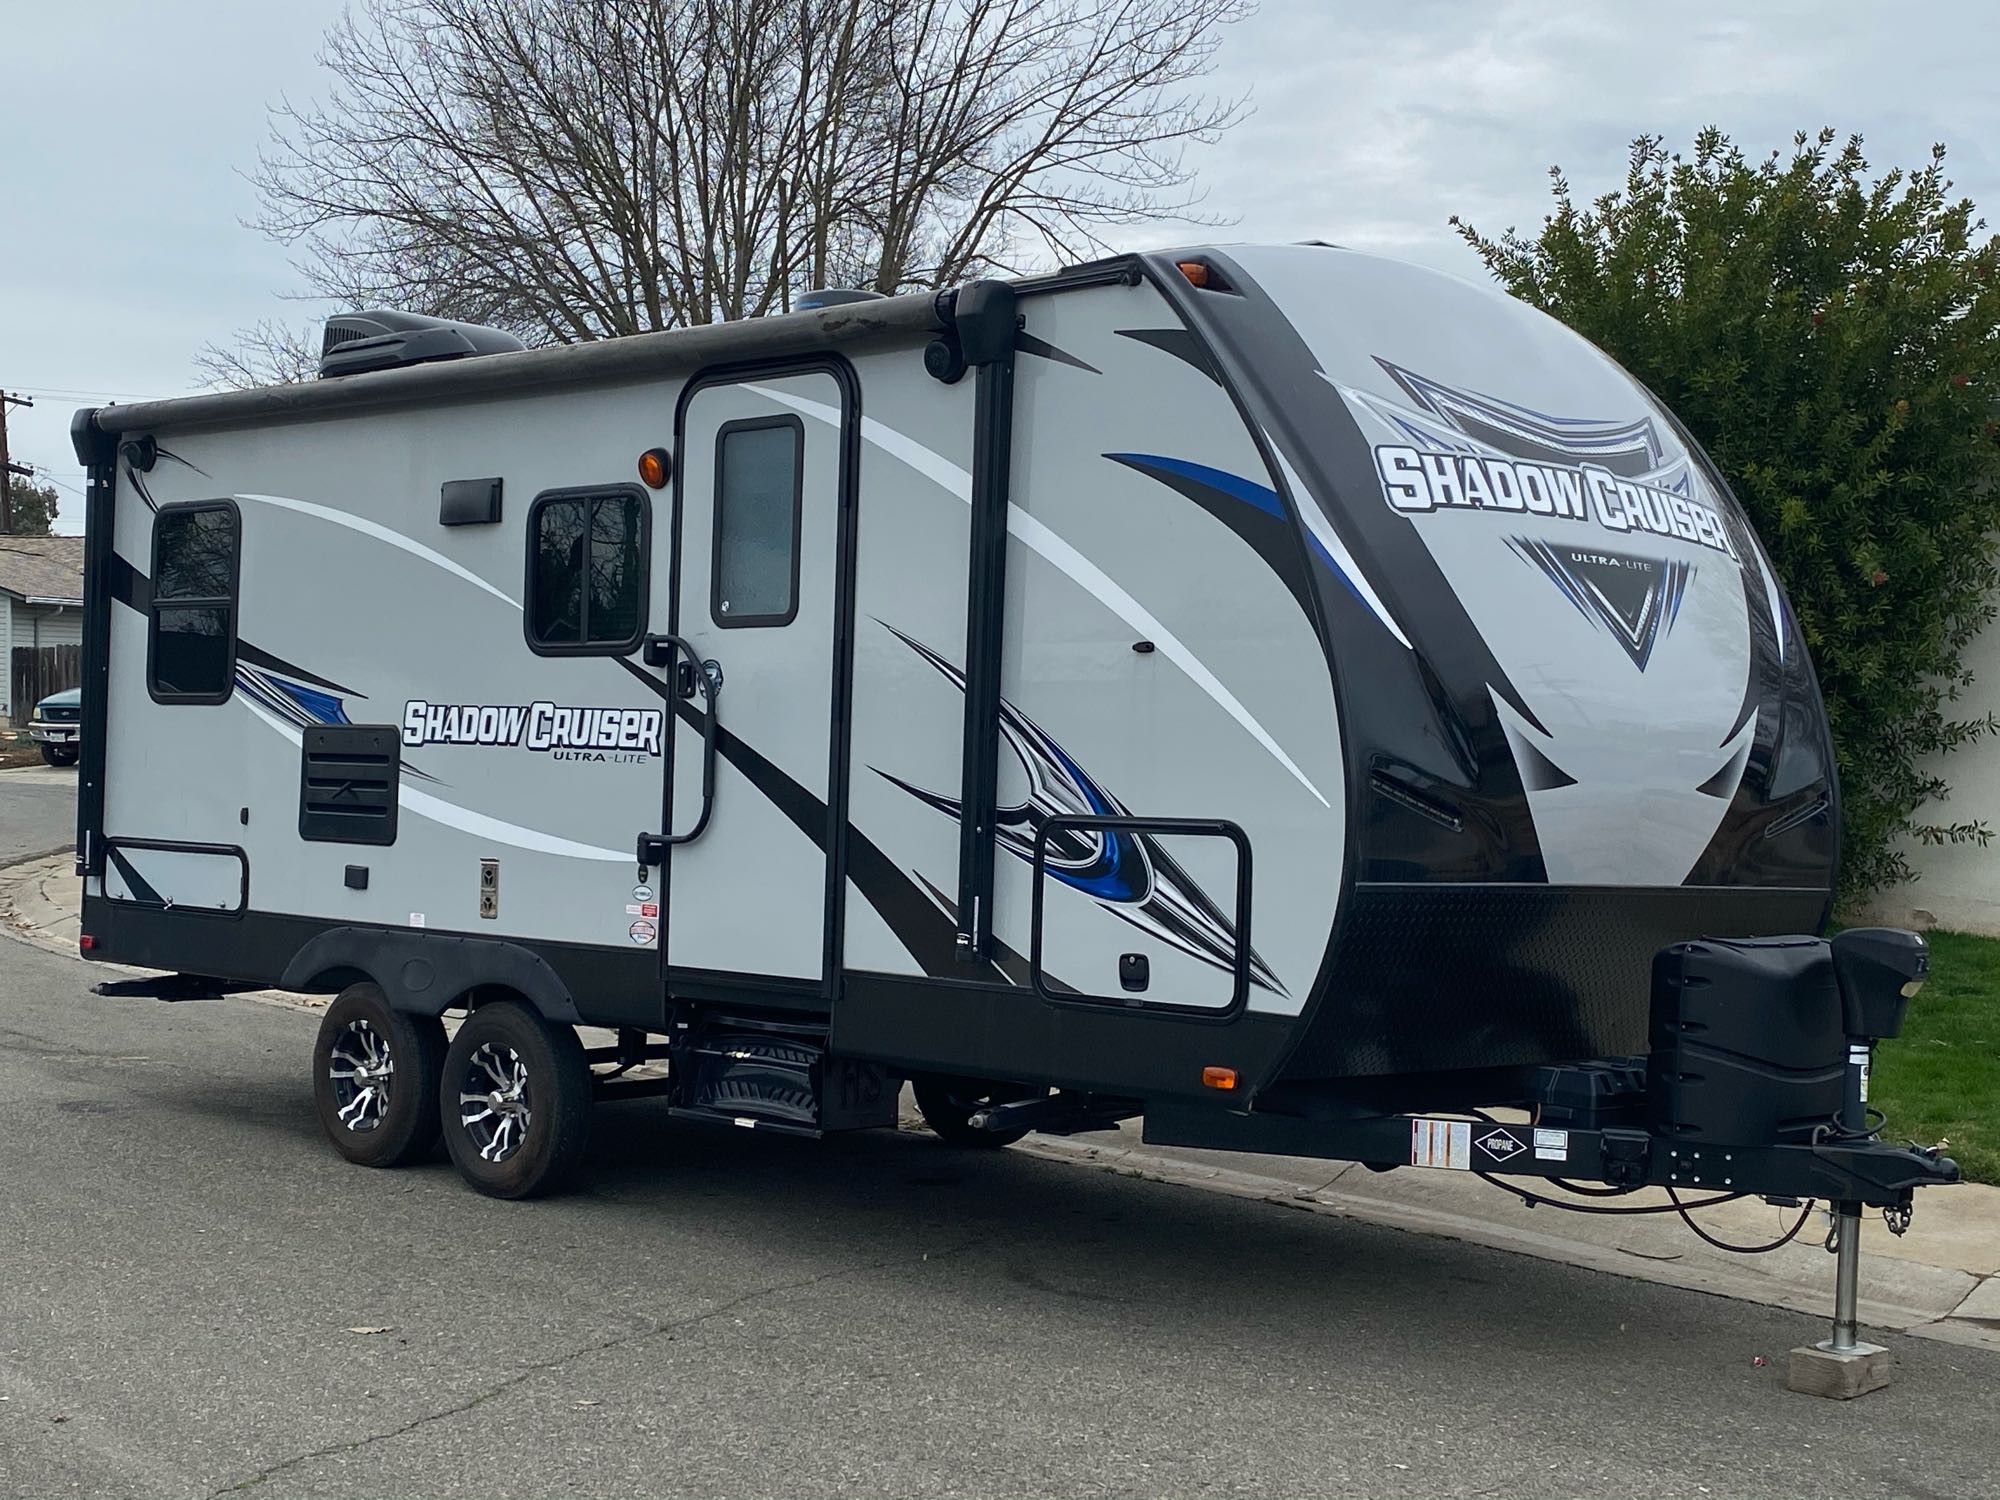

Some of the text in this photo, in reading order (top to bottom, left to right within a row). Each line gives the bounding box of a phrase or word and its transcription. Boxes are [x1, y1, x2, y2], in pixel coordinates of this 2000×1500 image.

[1376, 446, 1588, 522] SHADOW
[1571, 552, 1653, 573] ULTRA-LITE
[402, 700, 529, 747] SHADOW
[553, 751, 647, 765] ULTRA-LITE
[1486, 1137, 1514, 1152] PROPANE
